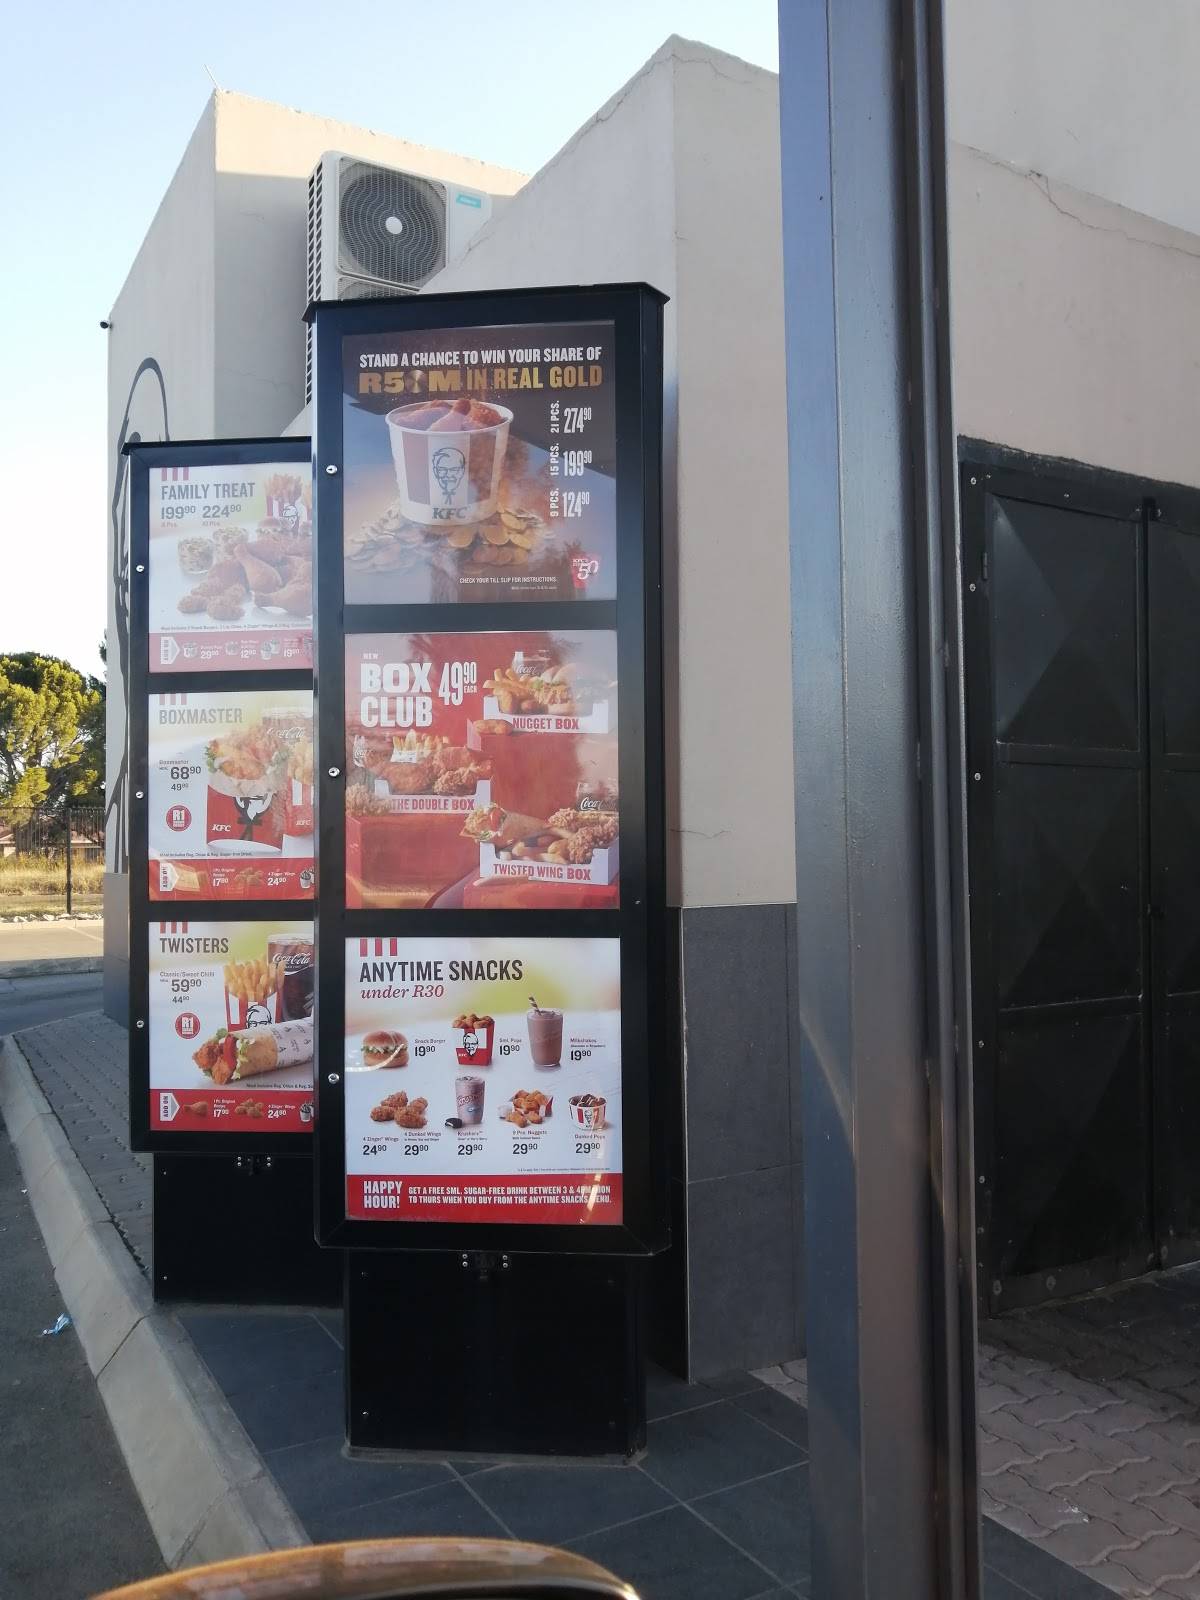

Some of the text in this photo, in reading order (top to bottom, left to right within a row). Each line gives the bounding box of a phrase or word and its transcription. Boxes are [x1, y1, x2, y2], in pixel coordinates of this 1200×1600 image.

[360, 346, 602, 368] STAND A CHANCE TO WIN YOUR SHARE OF
[466, 367, 488, 390] IN
[494, 367, 544, 390] REAL
[549, 364, 603, 388] GOLD
[551, 400, 560, 433] 21 PCS.
[550, 443, 559, 476] 15 PCS.
[161, 482, 256, 501] FAMILY TREAT
[550, 488, 559, 509] PCS.
[431, 507, 467, 520] KFC
[360, 662, 433, 693] BOX
[159, 708, 243, 725] BOXMASTER
[360, 696, 433, 728] CLUB
[512, 717, 580, 730] NUGGET BOX
[391, 799, 475, 810] THE DOUBLE BOX
[212, 823, 231, 832] KFC
[493, 863, 592, 881] TWISTED WING BOX
[159, 937, 229, 954] TWISTERS
[359, 959, 523, 983] ANYTIME SNACKS
[360, 984, 445, 999] under R30
[363, 1180, 403, 1194] HAPPY
[408, 1186, 421, 1195] GET
[422, 1187, 428, 1195] A
[428, 1187, 445, 1195] FREE
[446, 1187, 463, 1195] SML.
[463, 1187, 505, 1195] SUGAR-FREE
[506, 1186, 528, 1195] DRINK
[529, 1186, 561, 1195] BETWEEN
[562, 1186, 567, 1194] 3
[569, 1186, 575, 1194] &
[363, 1195, 400, 1209] HOUR!
[408, 1195, 418, 1204] TO
[419, 1196, 441, 1204] THURS
[442, 1196, 462, 1204] WHEN
[463, 1196, 477, 1204] YOU
[478, 1196, 493, 1204] BUY
[493, 1196, 513, 1204] FROM
[514, 1196, 528, 1204] THE
[528, 1195, 560, 1204] ANYTIME
[561, 1195, 589, 1204] SNACKS
